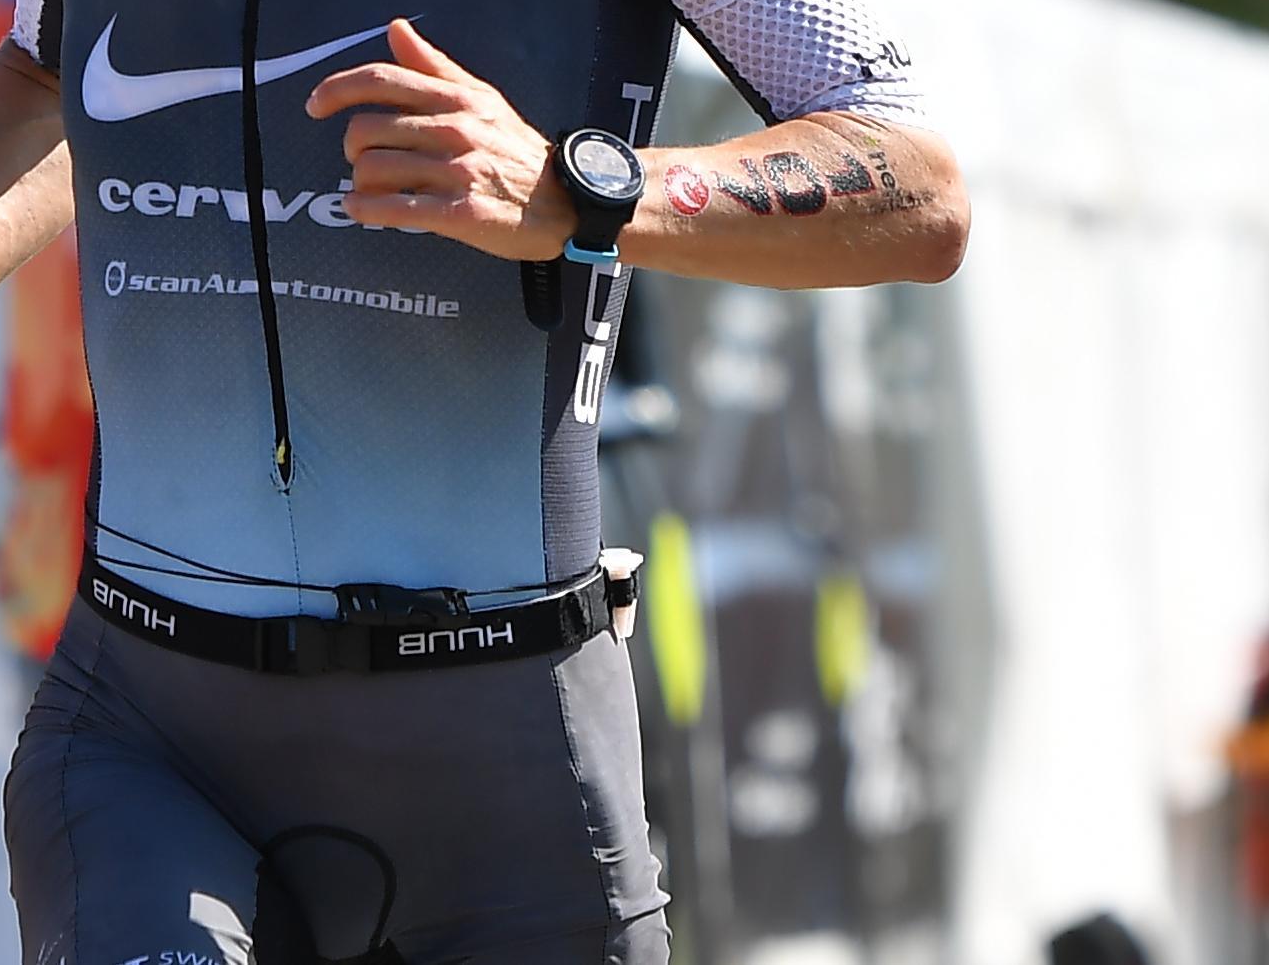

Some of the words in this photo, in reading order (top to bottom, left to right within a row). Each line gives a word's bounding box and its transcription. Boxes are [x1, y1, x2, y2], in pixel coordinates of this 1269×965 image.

[97, 178, 430, 234] cervé
[92, 578, 175, 637] HUUB
[399, 621, 514, 655] HUUB
